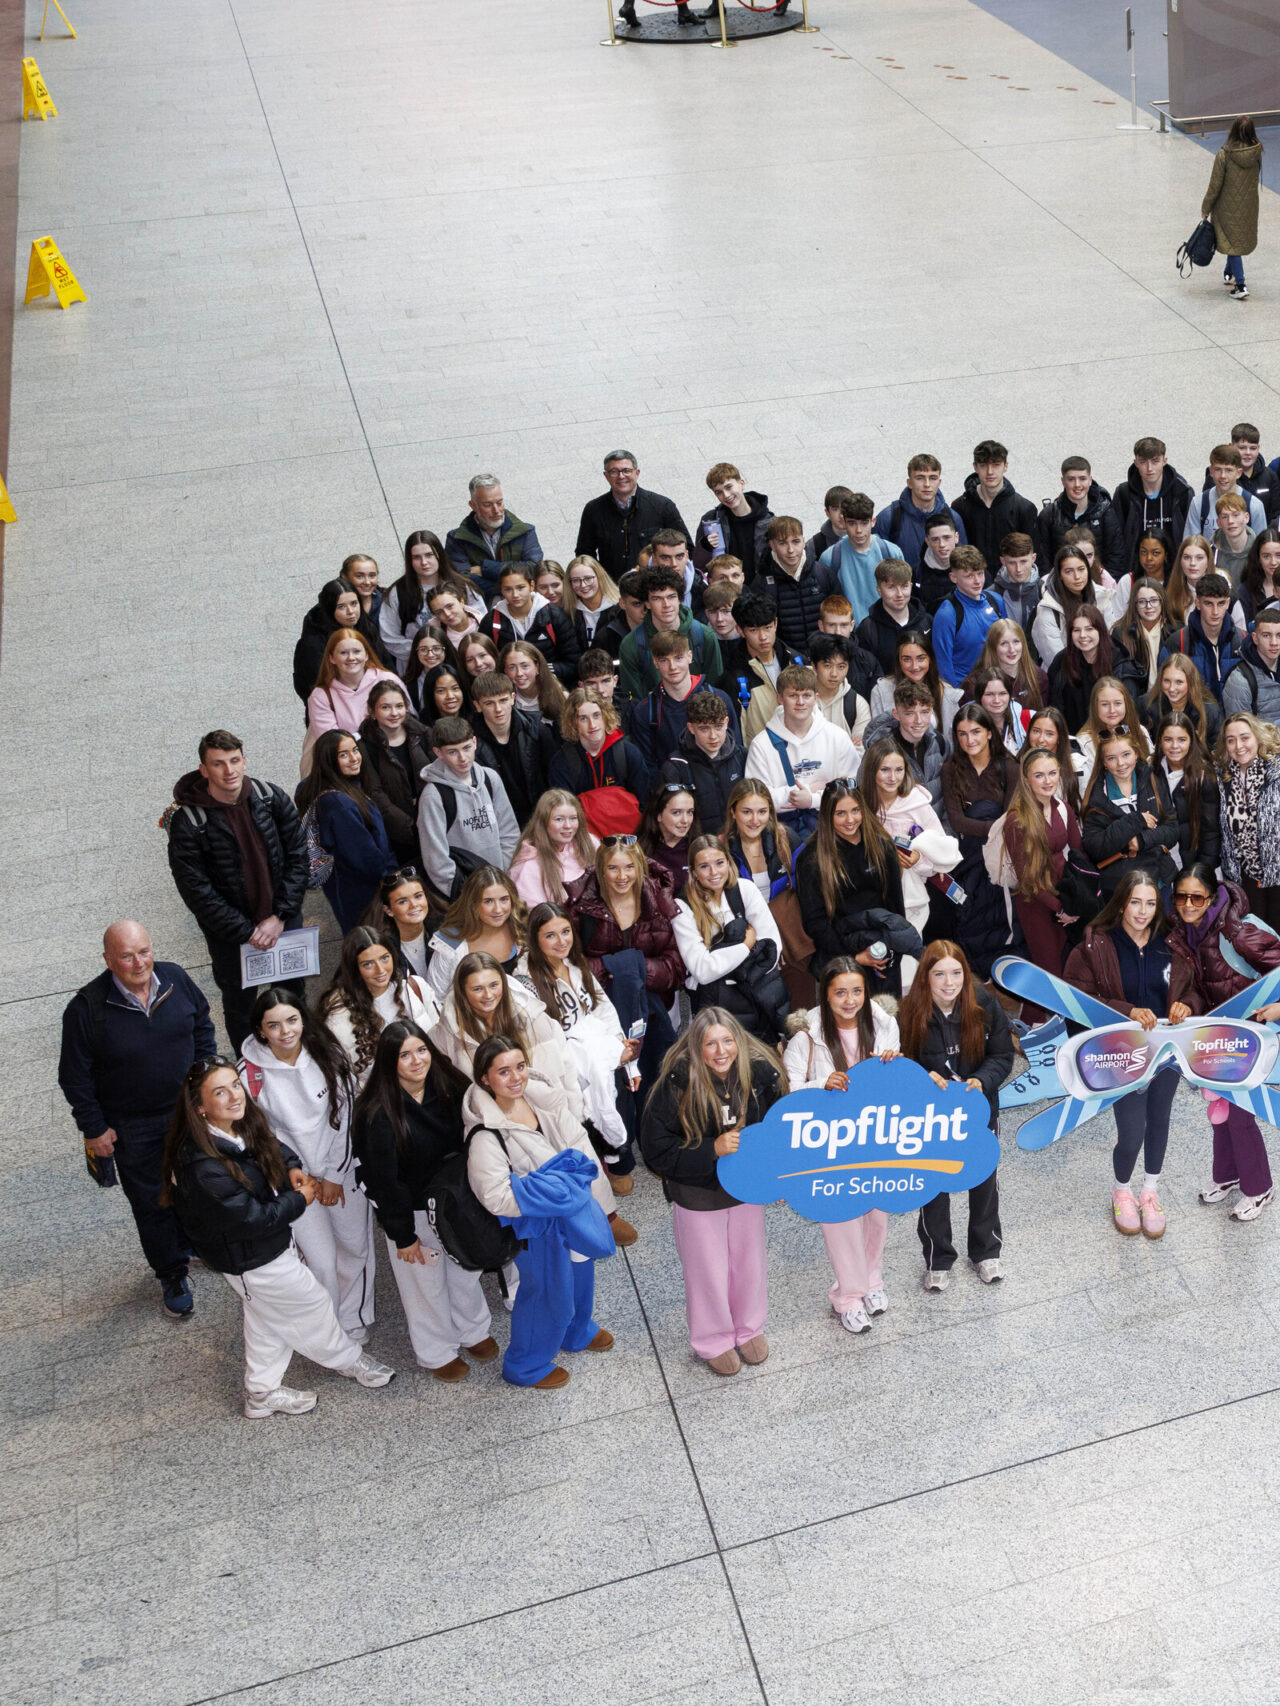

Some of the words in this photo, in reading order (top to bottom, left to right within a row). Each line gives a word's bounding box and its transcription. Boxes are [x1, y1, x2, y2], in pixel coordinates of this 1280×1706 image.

[58, 280, 74, 288] FLOOR
[1192, 1037, 1250, 1053] Topflight
[1084, 1052, 1131, 1062] shannon
[1094, 1060, 1130, 1069] AIRPORT
[782, 1103, 968, 1159] Topflight
[812, 1179, 844, 1196] For
[848, 1174, 924, 1195] Schools
